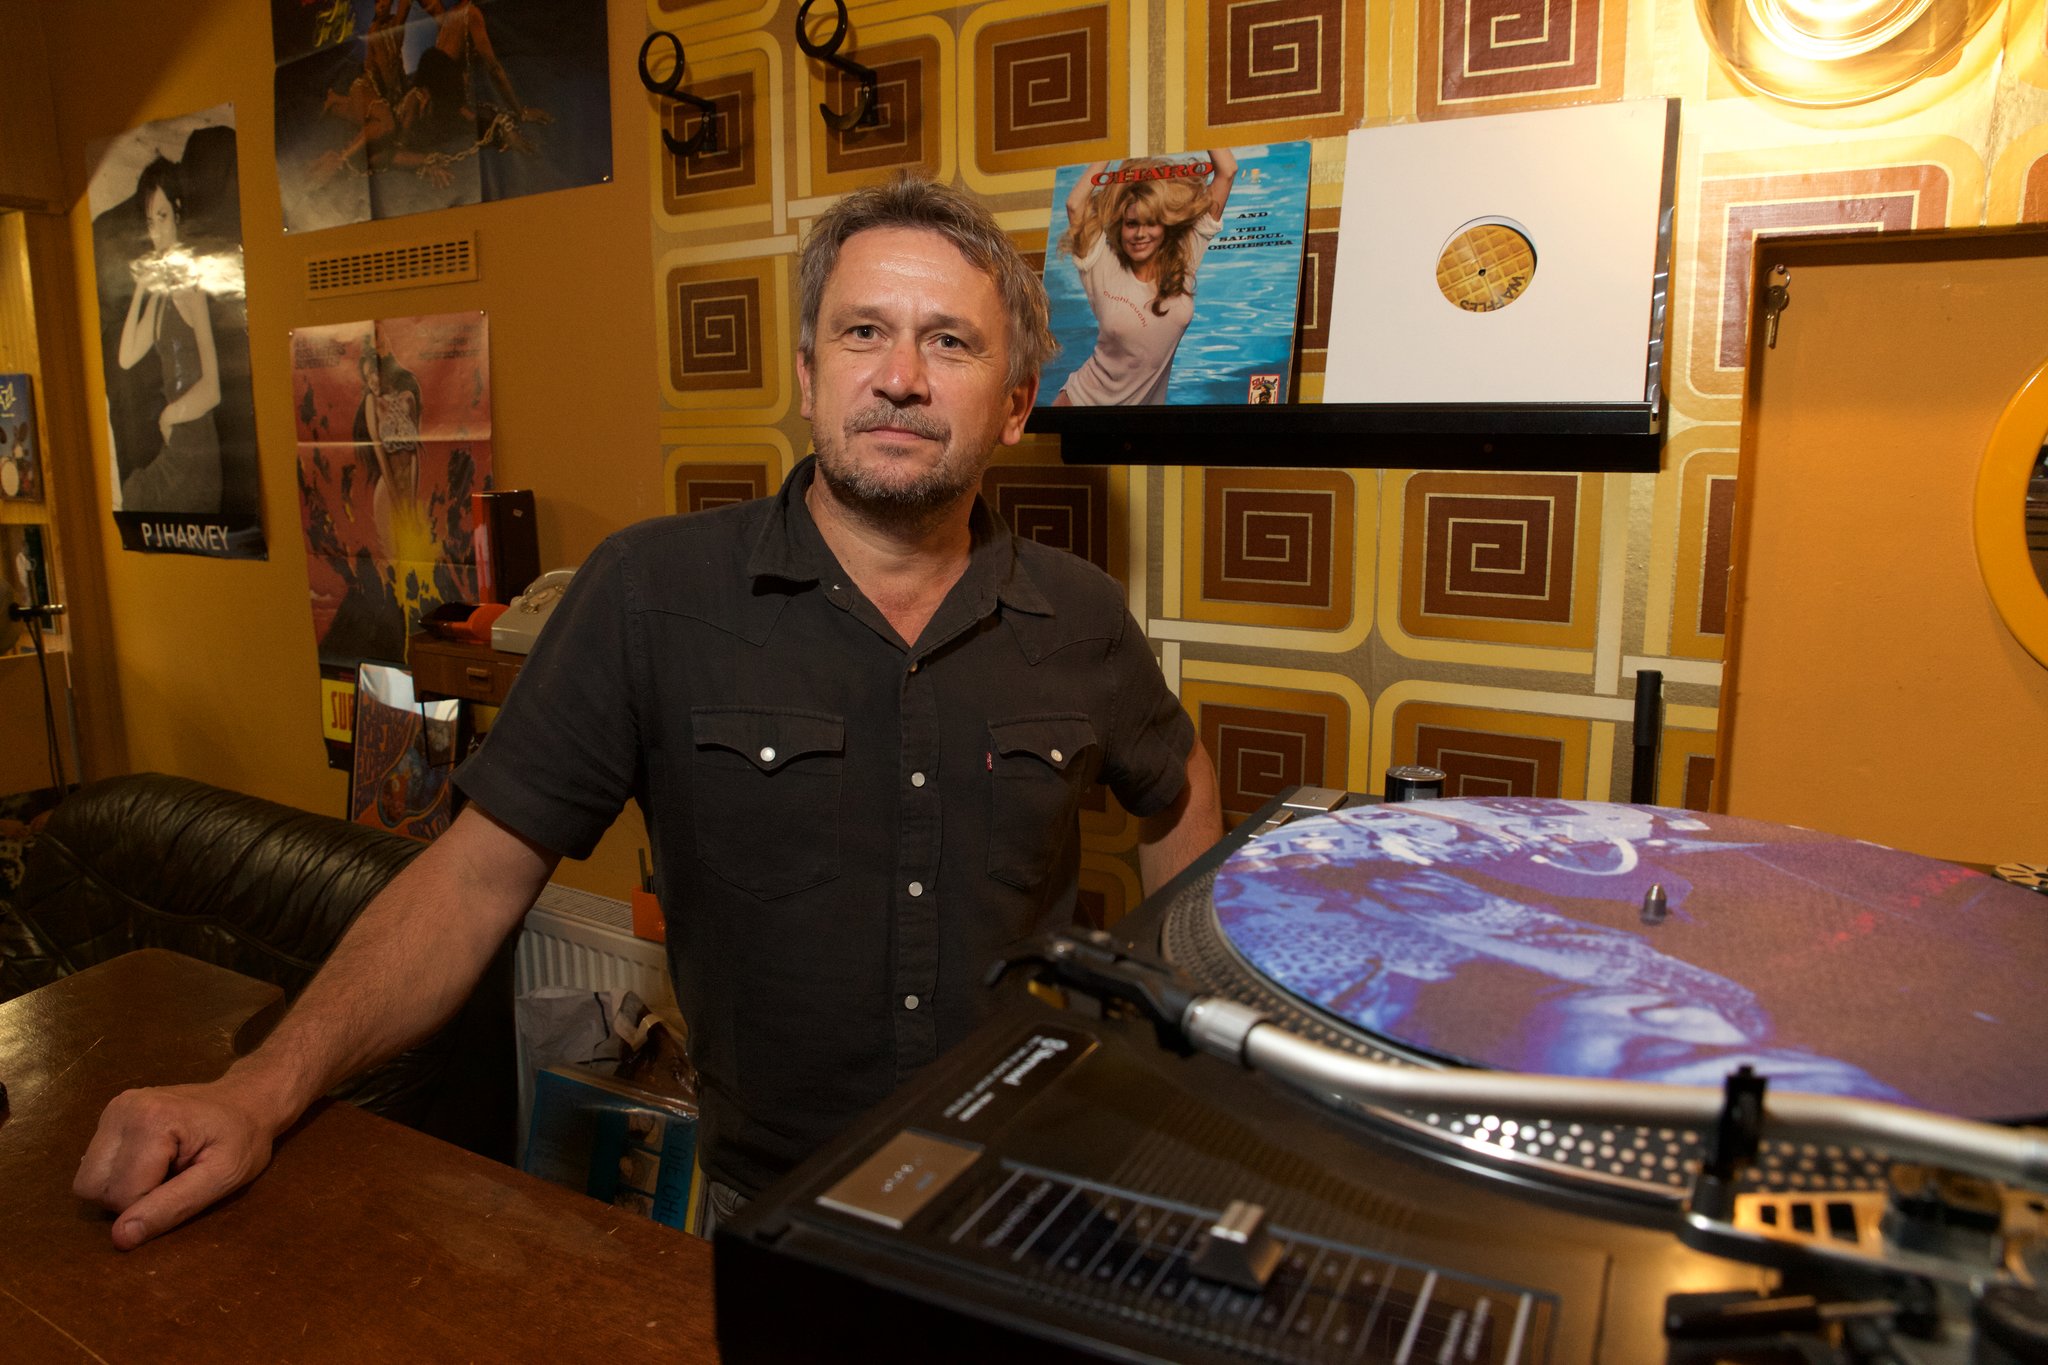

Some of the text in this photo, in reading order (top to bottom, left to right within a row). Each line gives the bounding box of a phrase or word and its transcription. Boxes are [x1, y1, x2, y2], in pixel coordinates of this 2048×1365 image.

[1090, 162, 1215, 187] CHARO
[1236, 211, 1269, 219] AND
[1235, 225, 1267, 233] THE
[1218, 232, 1285, 243] SALSOUL
[1207, 239, 1294, 251] ORCHESTRA
